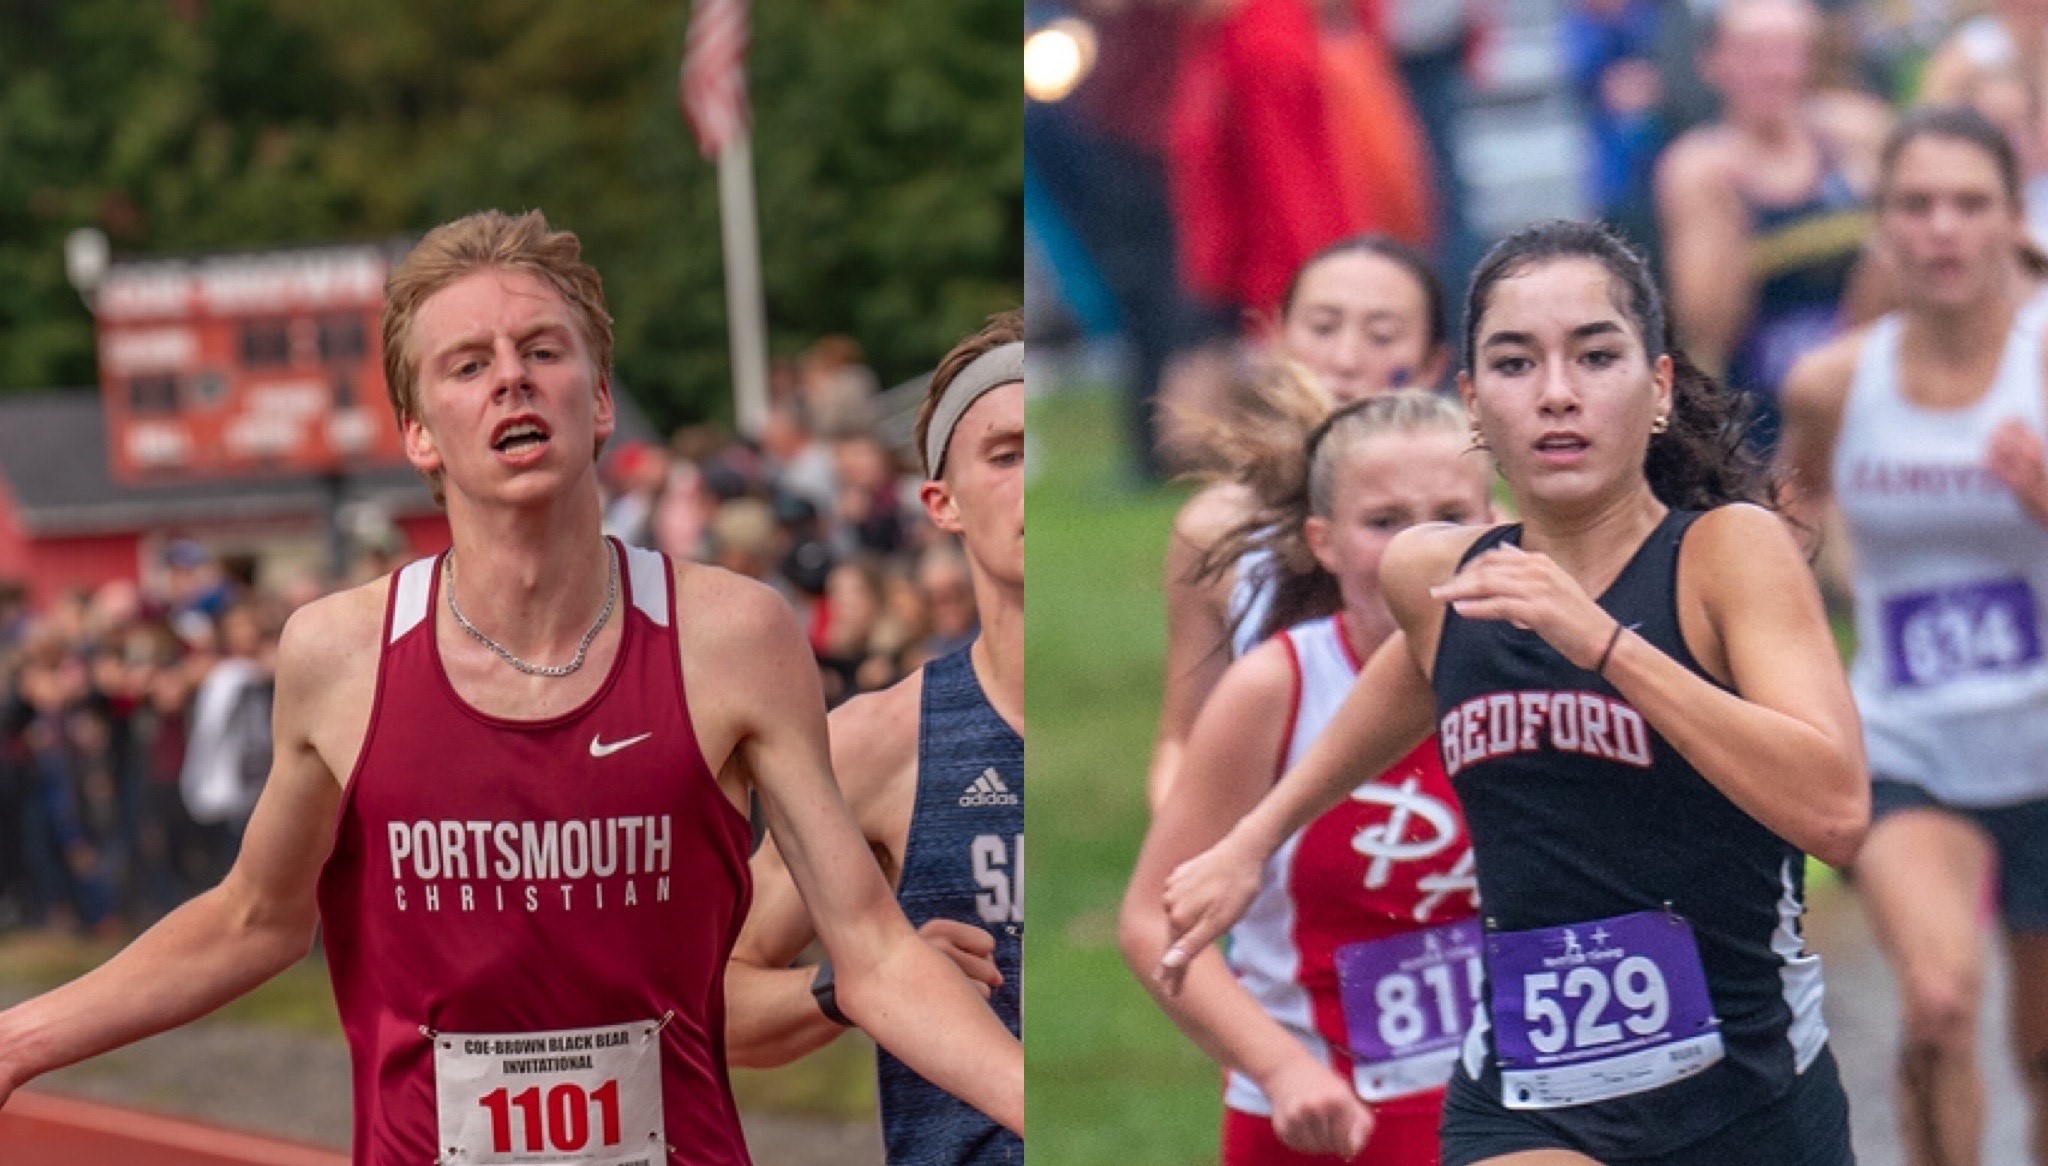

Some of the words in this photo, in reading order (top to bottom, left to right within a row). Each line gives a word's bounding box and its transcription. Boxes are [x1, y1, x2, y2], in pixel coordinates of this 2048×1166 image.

[1440, 690, 1653, 777] BEDFORD
[959, 792, 1018, 807] adidas
[387, 815, 671, 881] PORTSMOUTH
[395, 876, 670, 912] CHRISTIAN
[1523, 955, 1670, 1054] 529
[464, 1038, 545, 1055] COE-BROWN
[549, 1035, 593, 1052] BLACK
[596, 1031, 629, 1050] BEAR
[503, 1055, 593, 1074] INVITATIONAL
[479, 1079, 621, 1153] 1101
